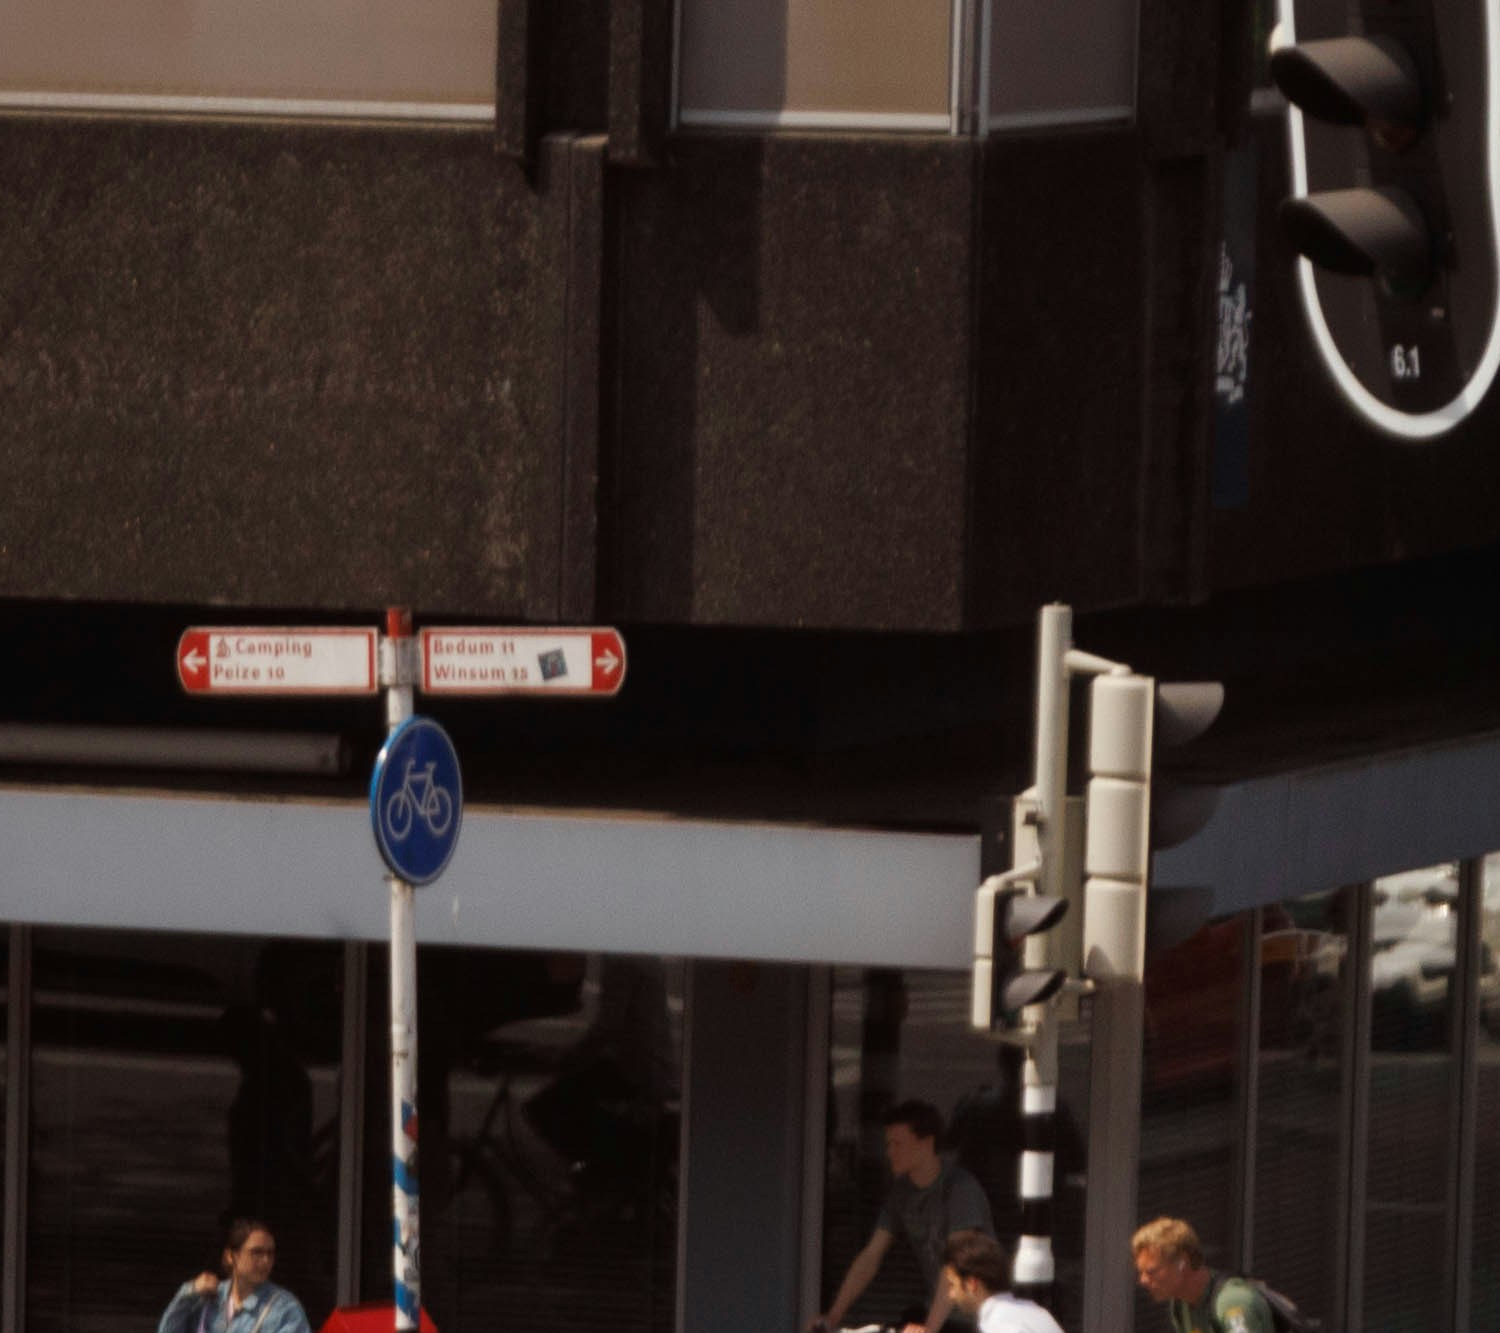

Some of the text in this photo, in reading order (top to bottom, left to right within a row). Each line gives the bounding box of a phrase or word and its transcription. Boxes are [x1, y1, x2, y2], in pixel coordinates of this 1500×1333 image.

[1391, 343, 1421, 378] 6.1
[235, 637, 313, 659] Camping
[434, 637, 495, 655] Bedum
[213, 663, 261, 681] Peize
[434, 663, 506, 681] Winsum
